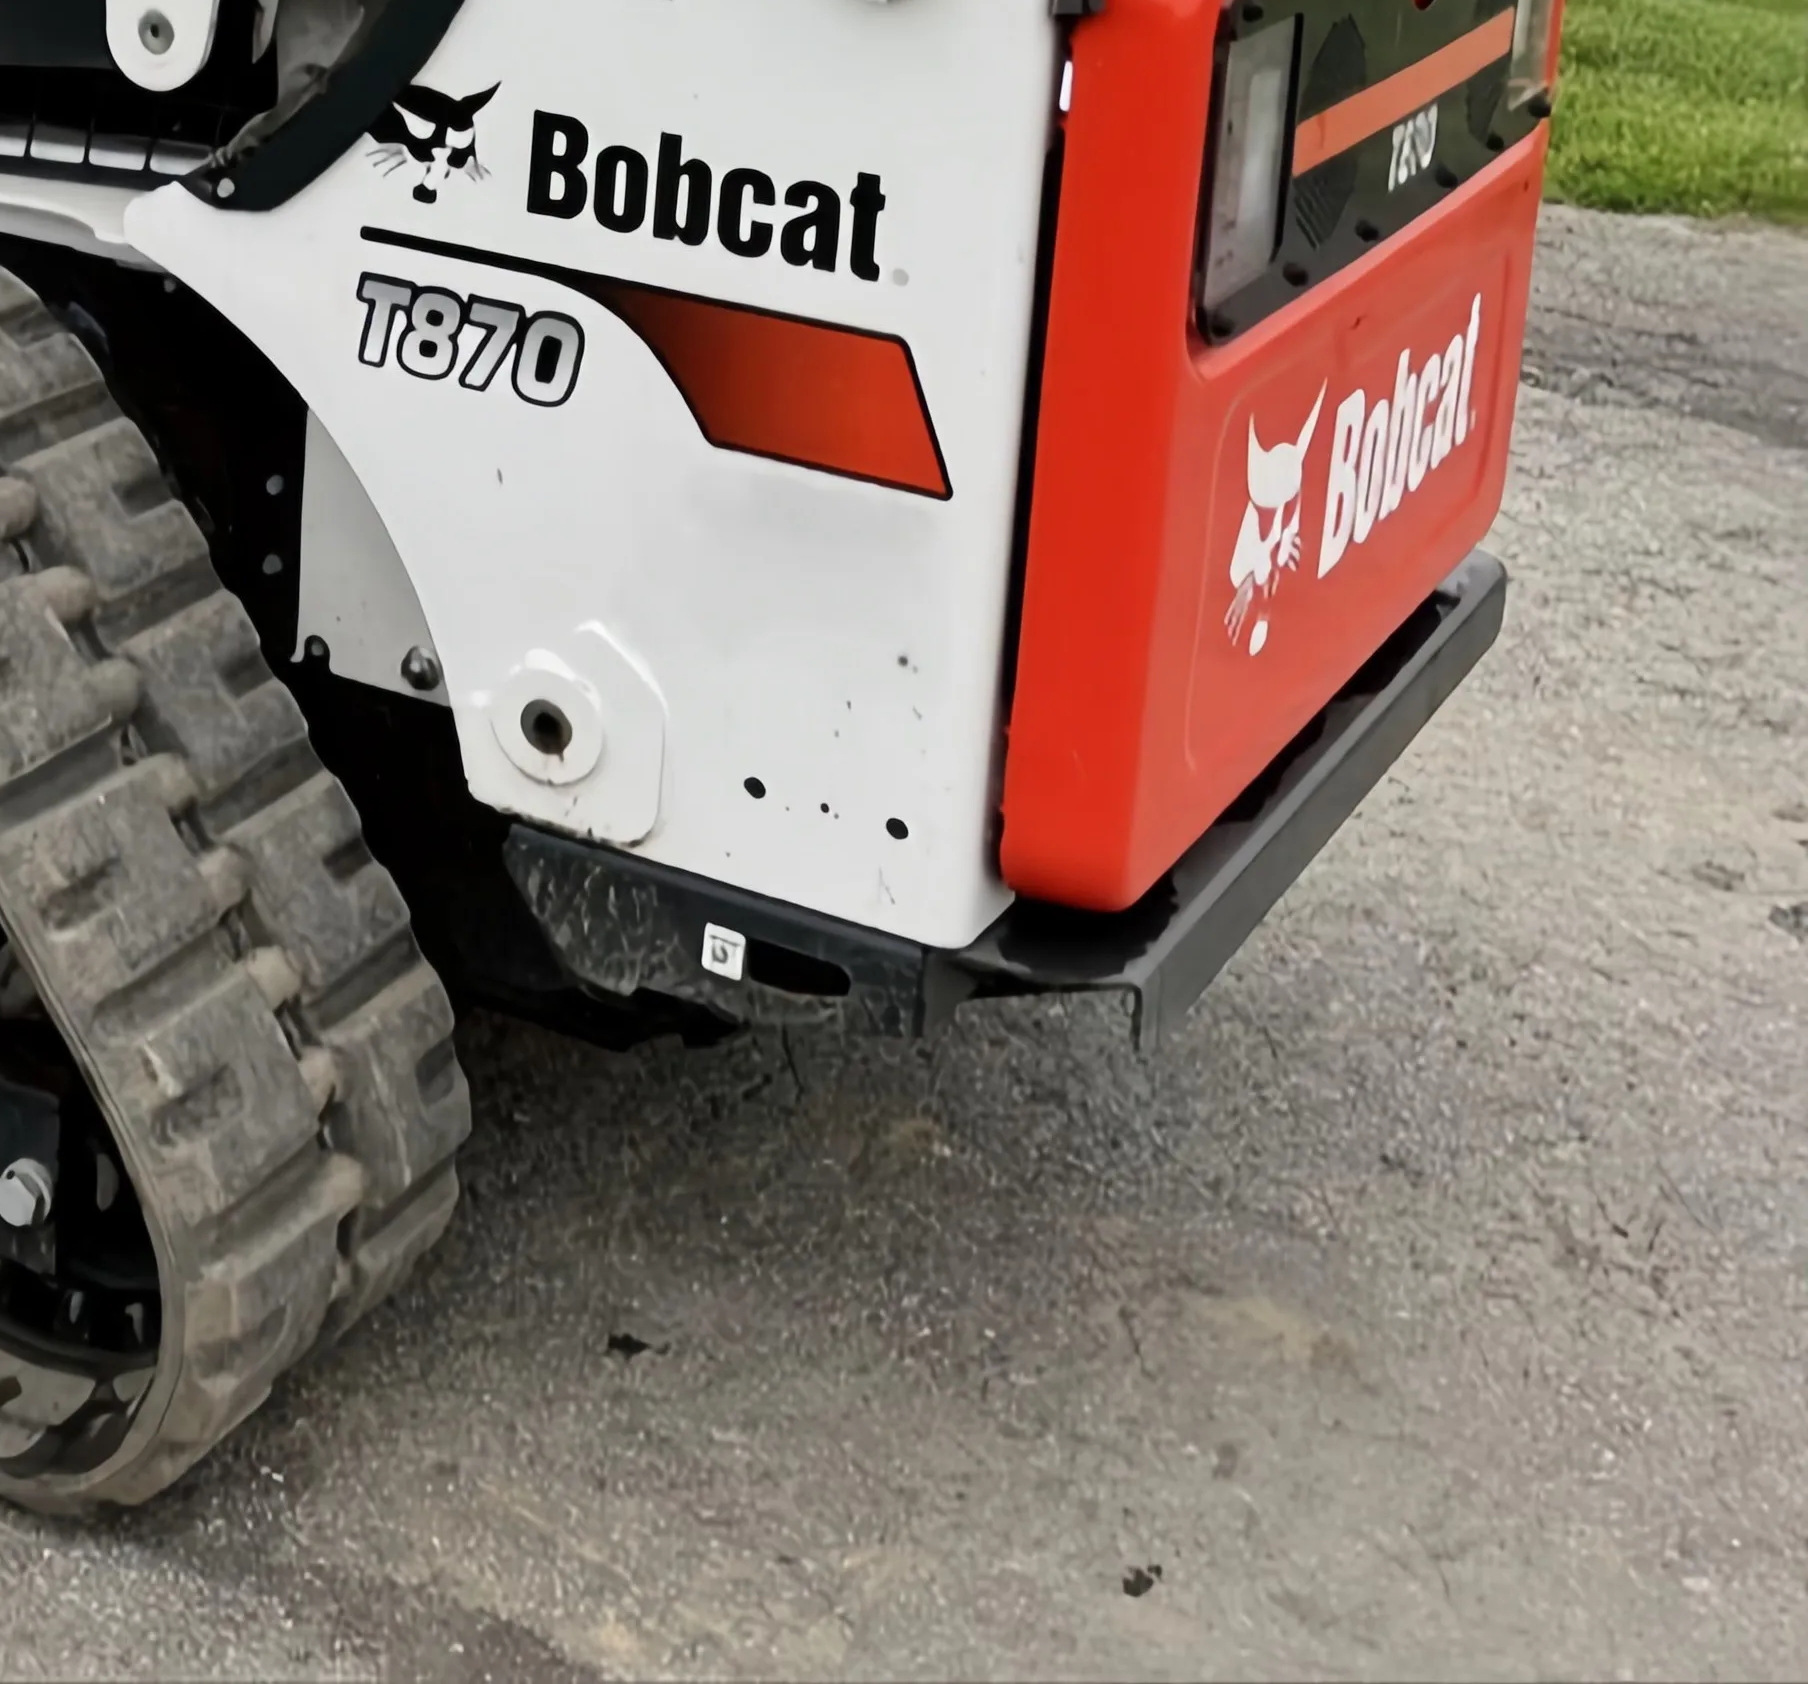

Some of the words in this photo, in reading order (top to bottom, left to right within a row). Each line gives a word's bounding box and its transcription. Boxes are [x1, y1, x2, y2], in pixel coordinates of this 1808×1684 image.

[526, 109, 886, 282] Bobcat
[356, 272, 585, 407] T870
[1317, 292, 1481, 580] Bobcat
